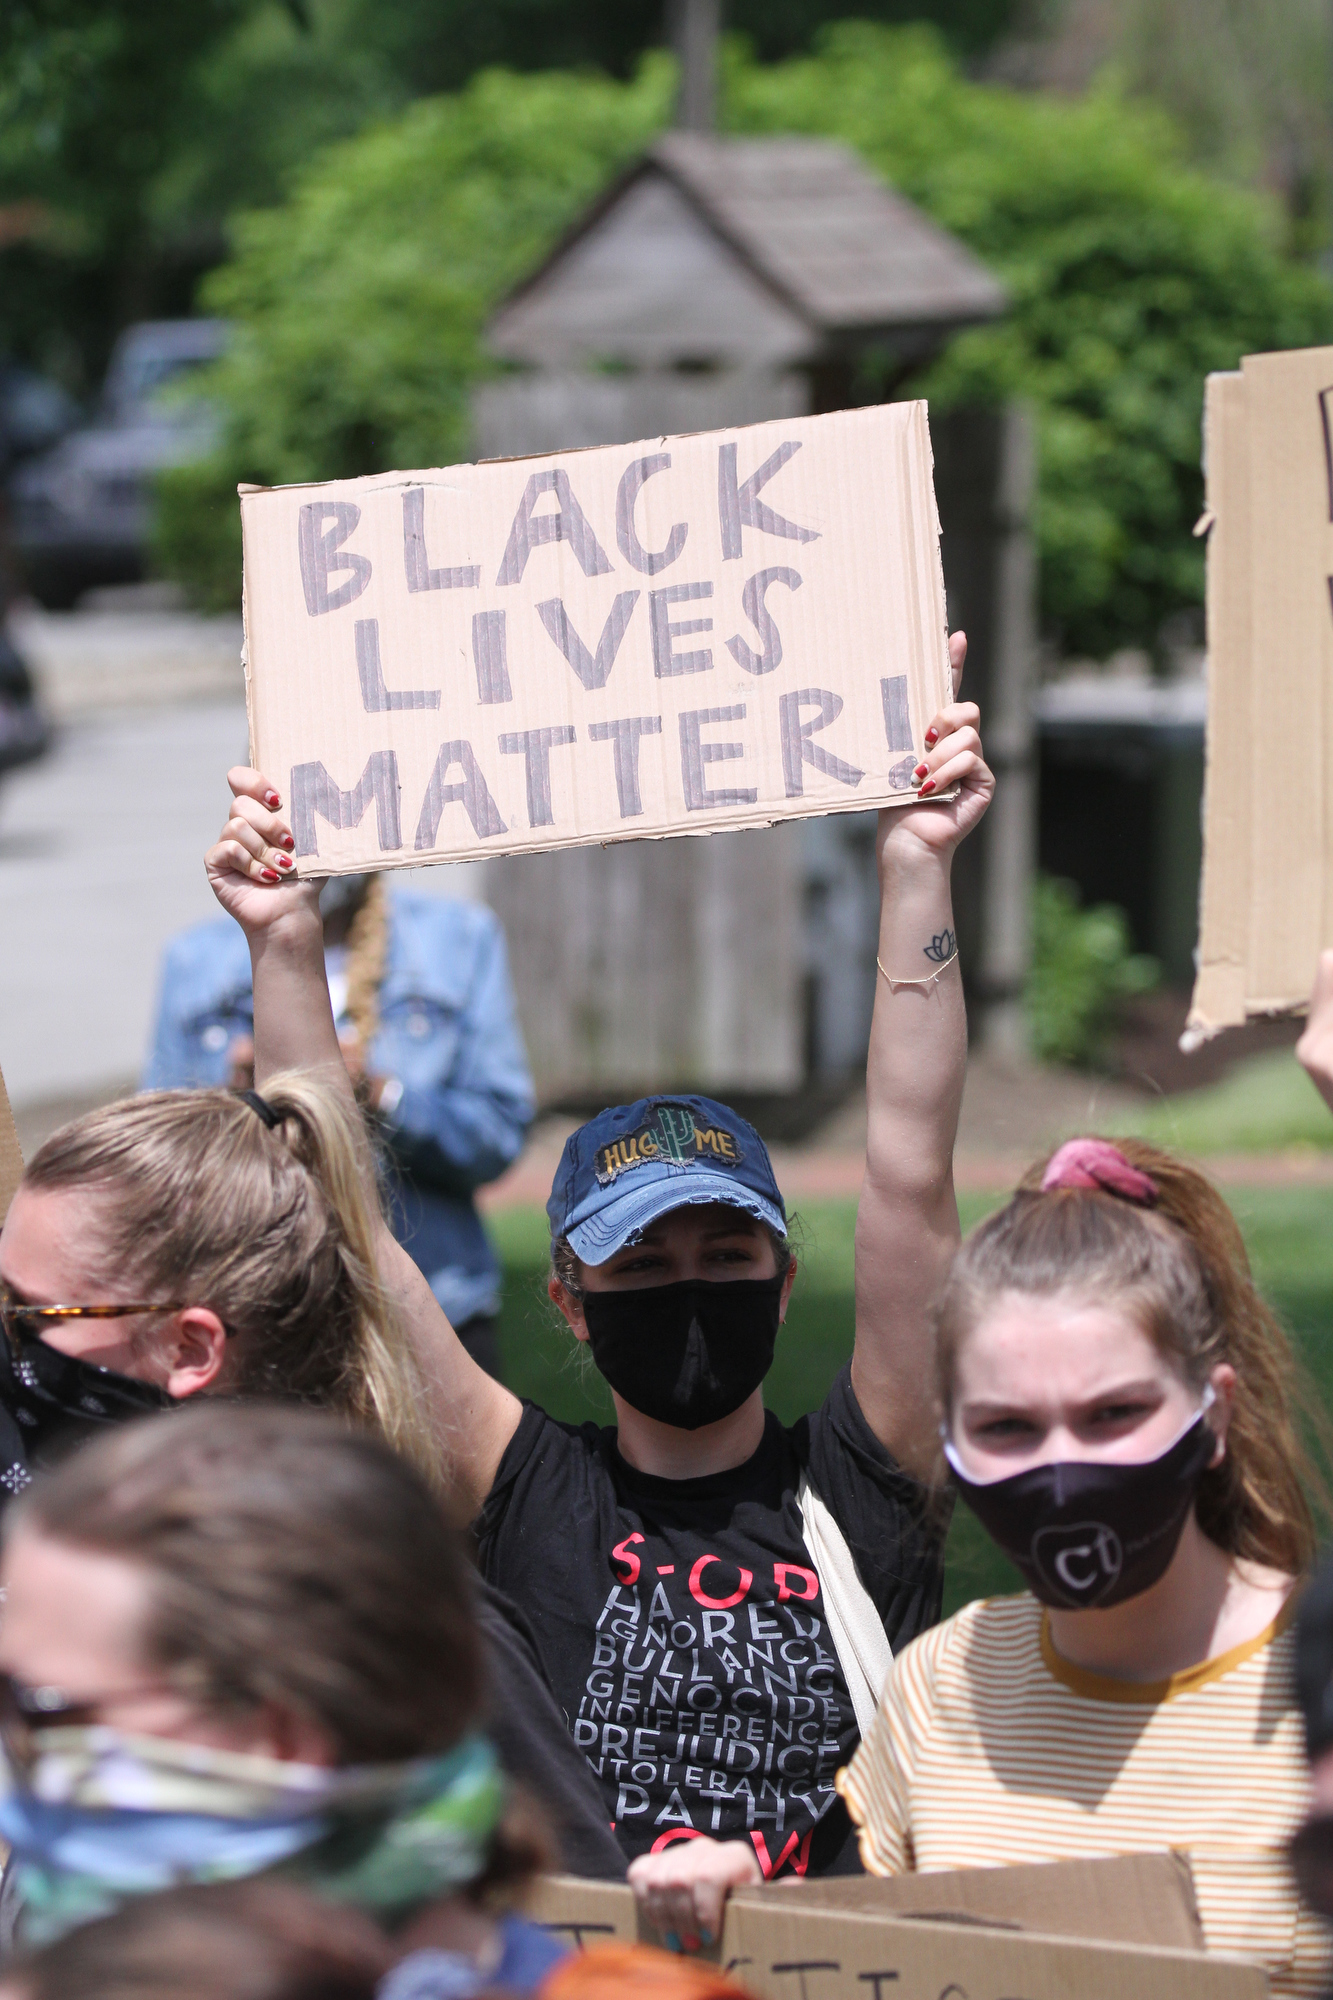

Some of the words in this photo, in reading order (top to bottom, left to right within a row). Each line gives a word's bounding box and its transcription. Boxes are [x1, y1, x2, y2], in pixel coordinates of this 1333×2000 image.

[299, 441, 822, 617] BLACK
[354, 566, 803, 713] LIVES
[290, 675, 918, 858] MATTER!
[603, 1132, 659, 1174] HUG
[693, 1128, 736, 1158] ME
[611, 1532, 820, 1610] SOP
[595, 1607, 835, 1671] IGNOANCE
[604, 1581, 821, 1648] HARED
[578, 1695, 841, 1745] INDIFFERENCE
[585, 1669, 843, 1722] GENOCIDE
[573, 1718, 841, 1779] PREJUDICE
[585, 1754, 837, 1800] NTOLERANCE
[615, 1781, 837, 1832] PATHY
